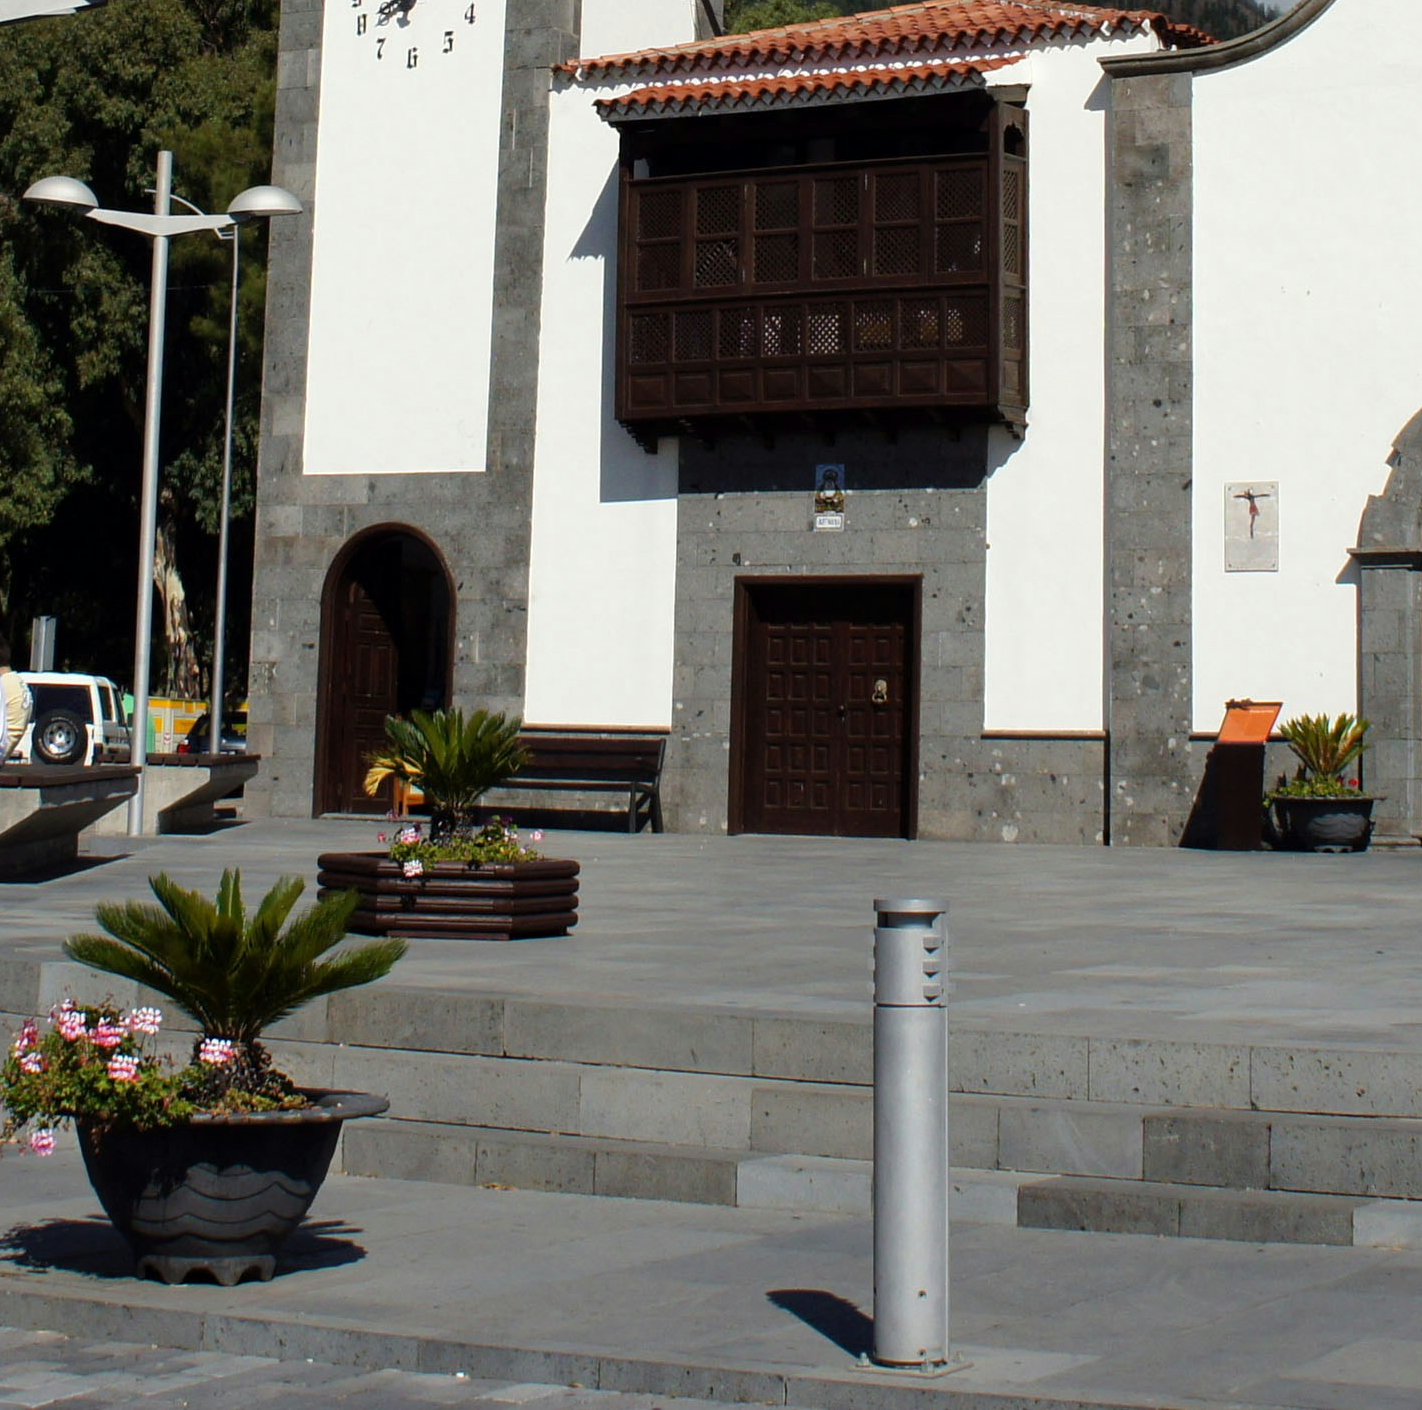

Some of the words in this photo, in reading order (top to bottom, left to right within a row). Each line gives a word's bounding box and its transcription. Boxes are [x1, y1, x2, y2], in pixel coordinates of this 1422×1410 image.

[356, 13, 367, 37] 8
[464, 3, 476, 25] 4
[376, 38, 386, 60] 7
[442, 31, 454, 54] 5
[407, 47, 419, 70] 6
